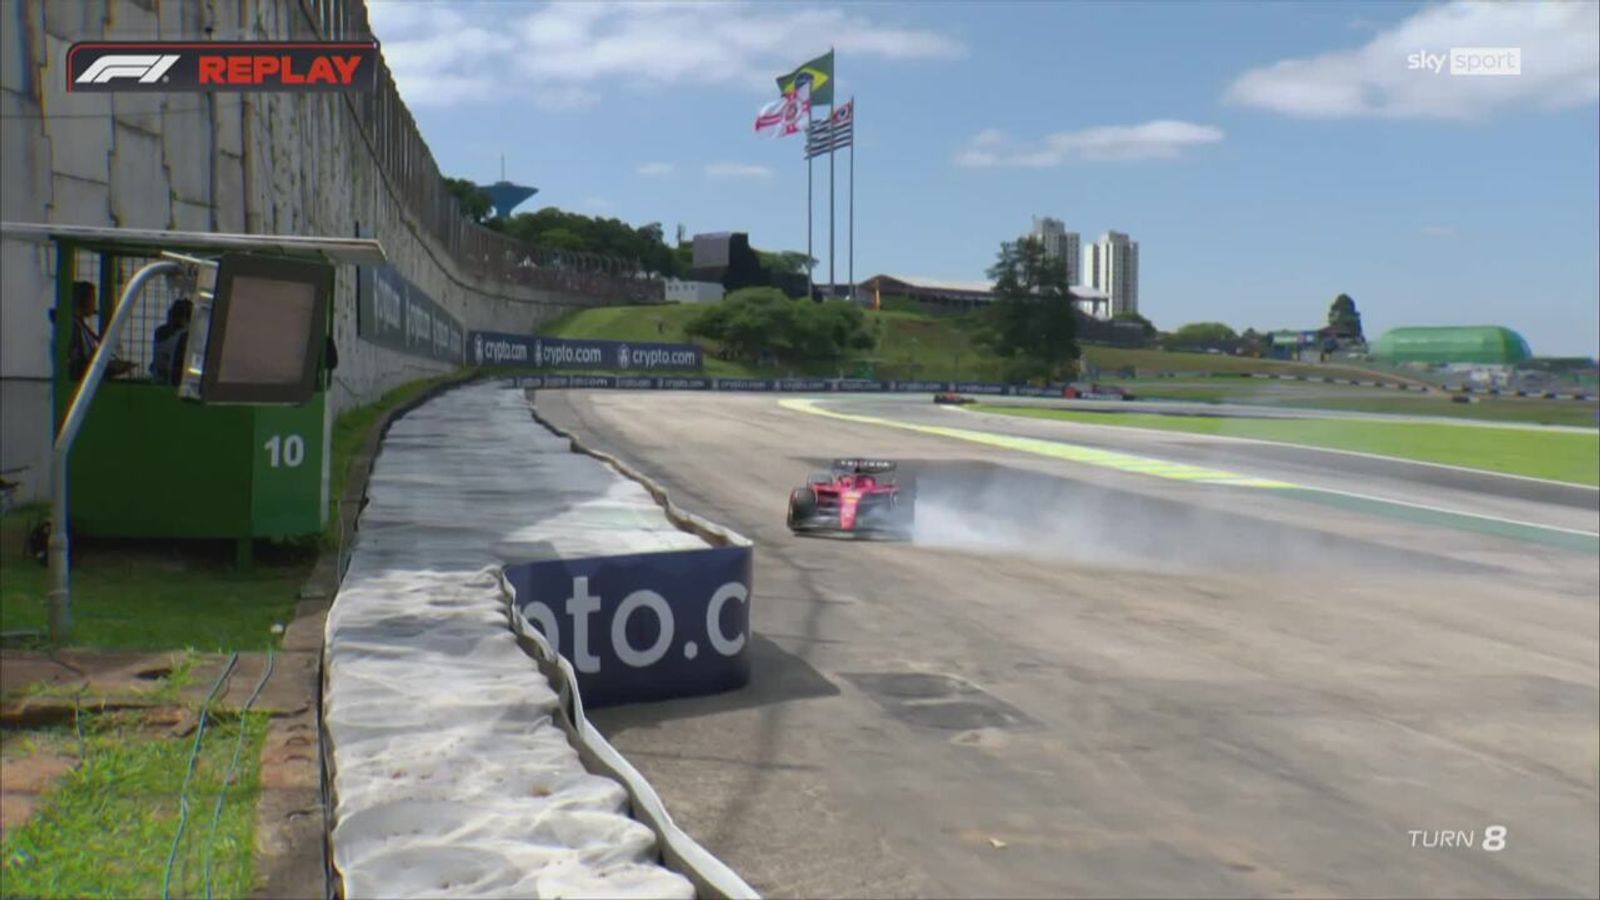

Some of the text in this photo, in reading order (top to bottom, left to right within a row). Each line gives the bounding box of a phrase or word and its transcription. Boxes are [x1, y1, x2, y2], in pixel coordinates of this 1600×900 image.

[543, 344, 602, 366] crypto.com
[632, 348, 696, 368] crypto.com
[264, 434, 304, 467] 10
